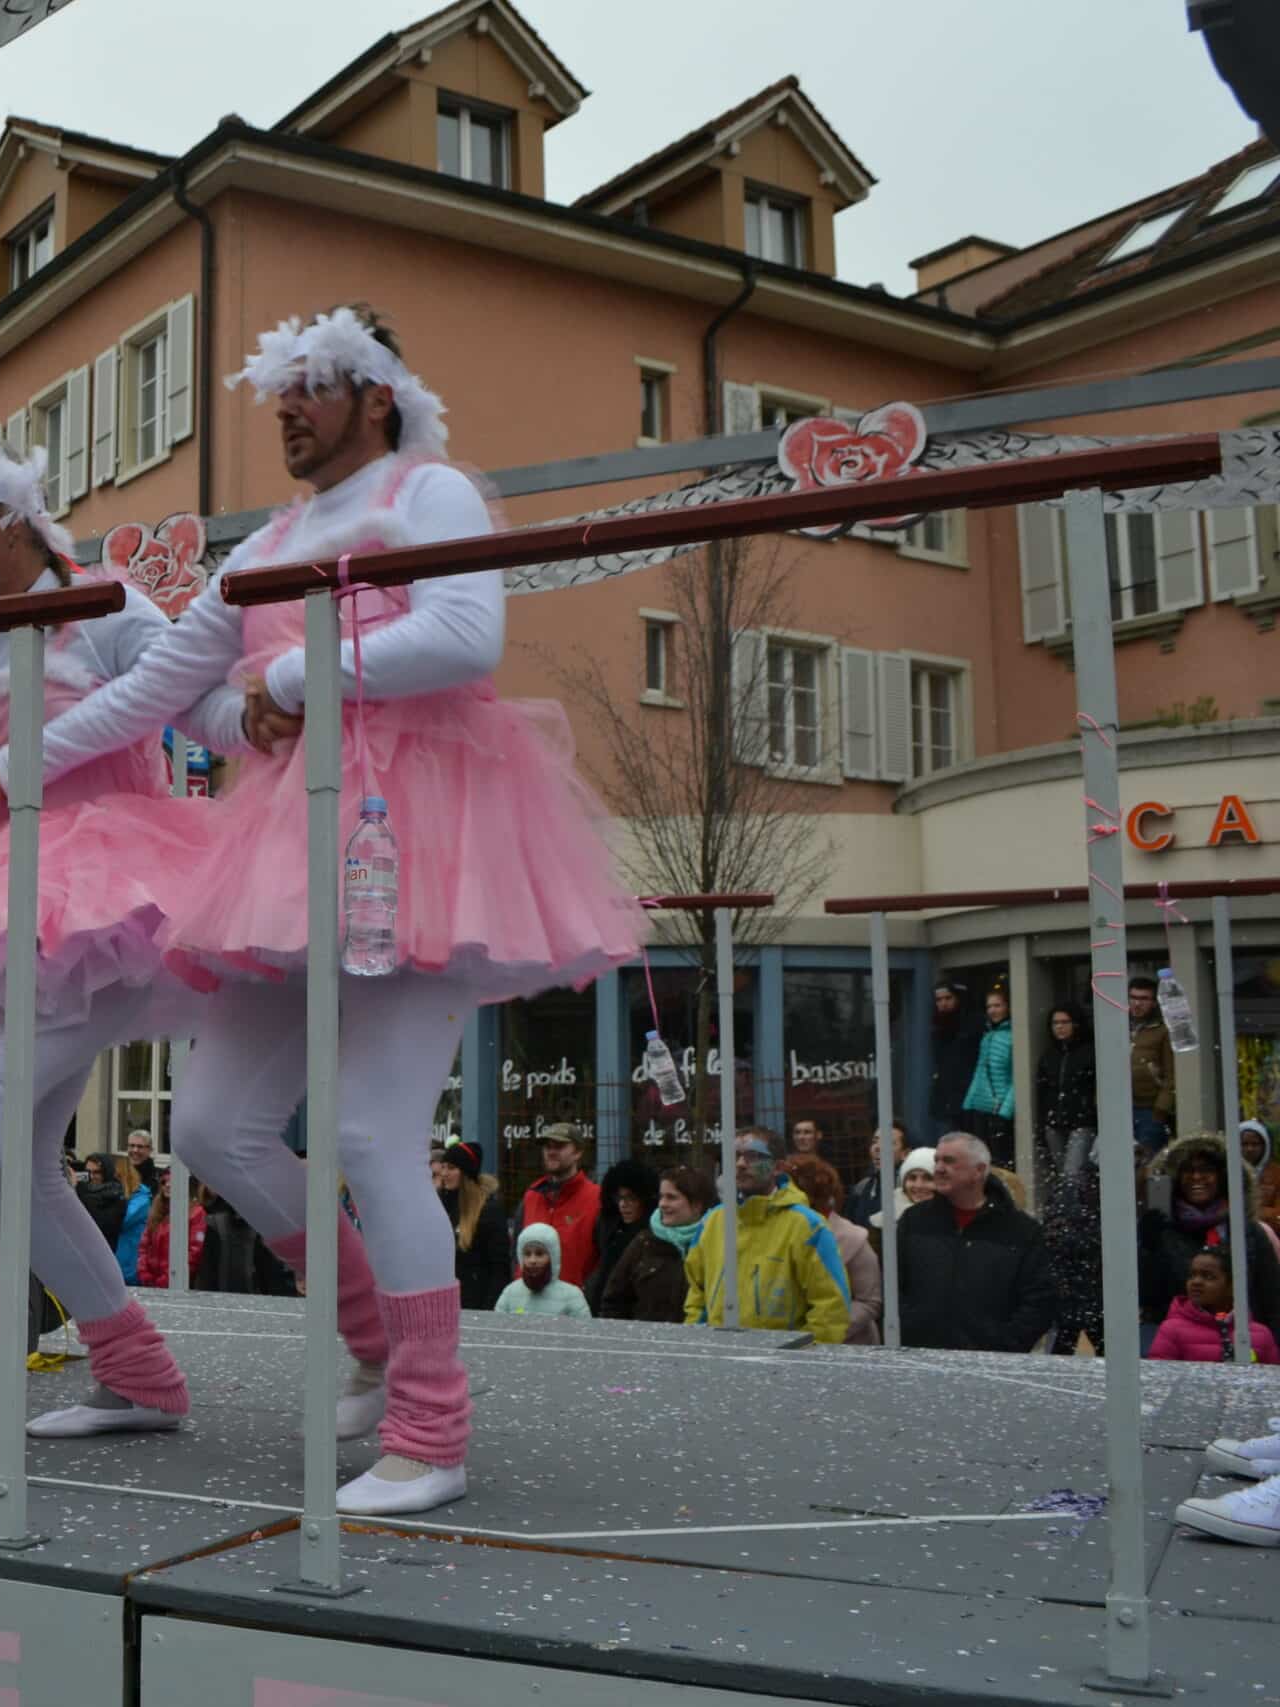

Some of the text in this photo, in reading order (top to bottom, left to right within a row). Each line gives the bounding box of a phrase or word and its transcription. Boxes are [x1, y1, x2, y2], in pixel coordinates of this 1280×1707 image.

[502, 1059, 521, 1091] le
[526, 1057, 577, 1099] poids
[503, 1124, 530, 1149] que
[643, 1119, 665, 1147] de
